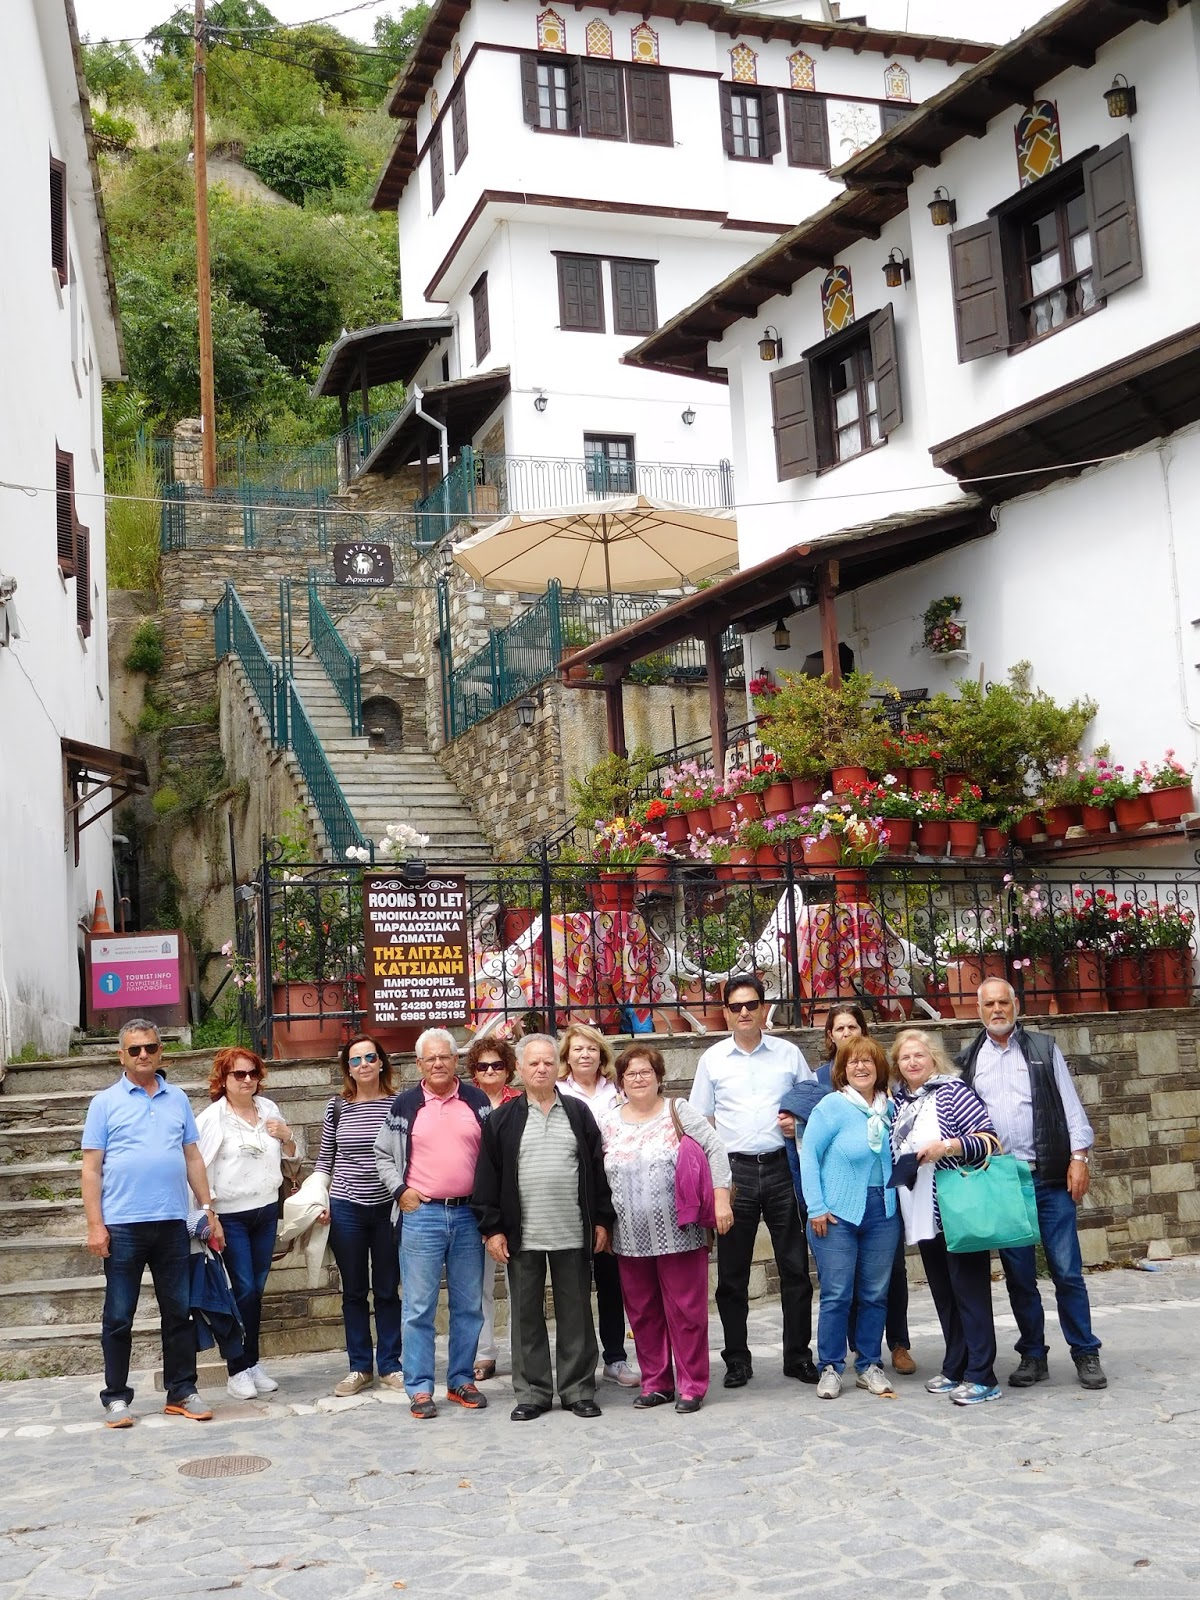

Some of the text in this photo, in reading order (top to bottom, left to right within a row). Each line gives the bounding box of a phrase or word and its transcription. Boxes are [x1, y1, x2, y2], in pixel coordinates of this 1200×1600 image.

[368, 893, 463, 908] ROOMS TO LET
[370, 911, 463, 921] ΕΝΟΙΚΙΑΖΟΝΤΑΙ
[374, 922, 460, 932] ΠΑΡΑΔΟΣΙΑΚΑ
[390, 934, 445, 943] ΔΩΜΑΤΙΑ
[373, 946, 463, 960] ΤΗΣ ΛΙΤΣΑΣ
[374, 961, 464, 976] ΚΑΤΣΙΑΝΗ
[383, 977, 455, 988] ΠΛΗΡΟΦΟΡΙΕΣ
[374, 988, 465, 999] ΕΝΤΟΣ ΤΗΣ ΑΥΛΗΣ
[373, 1000, 466, 1011] ΤΗΛ. 24280 99287
[375, 1011, 466, 1021] ΚΙΝ. 6985 925195
